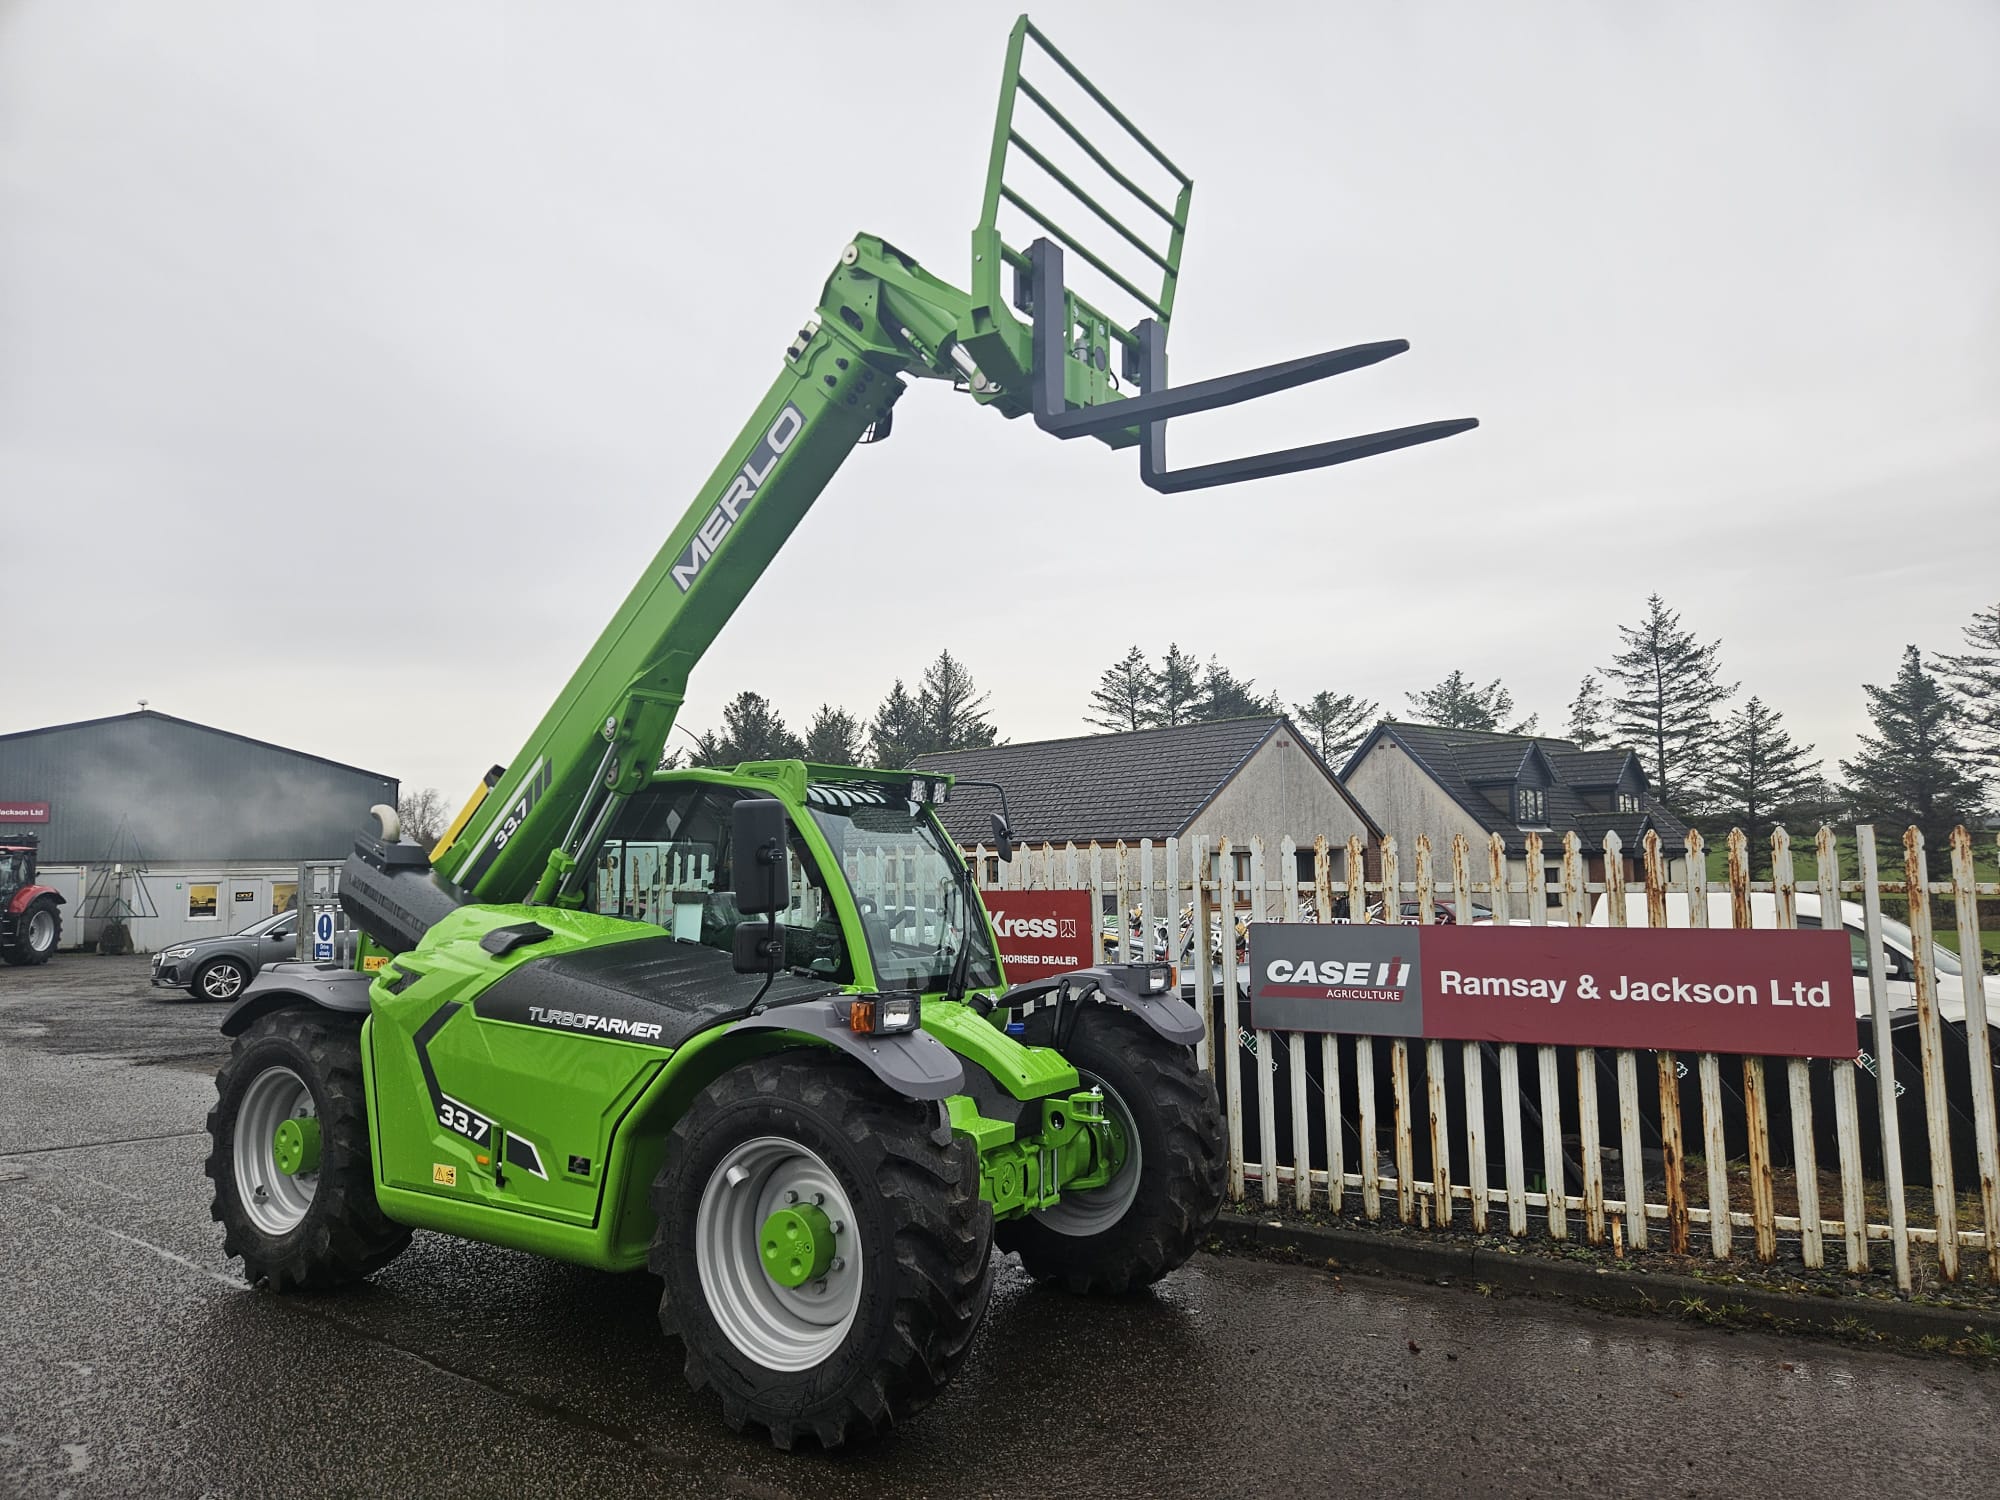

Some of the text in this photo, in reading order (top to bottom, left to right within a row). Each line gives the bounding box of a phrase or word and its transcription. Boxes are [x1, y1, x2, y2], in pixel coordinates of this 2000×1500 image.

[671, 406, 802, 591] MERLO
[494, 797, 527, 850] 33.7
[986, 910, 1058, 938] Kress
[1000, 954, 1078, 965] HORISED DEALER
[1266, 959, 1371, 985] CASE
[1326, 989, 1400, 1001] AGRICULTURE
[1440, 970, 1831, 1007] Ramsay & Jackson Ltd
[529, 1006, 662, 1039] TURBOFARMER
[439, 1103, 489, 1141] 33.7
